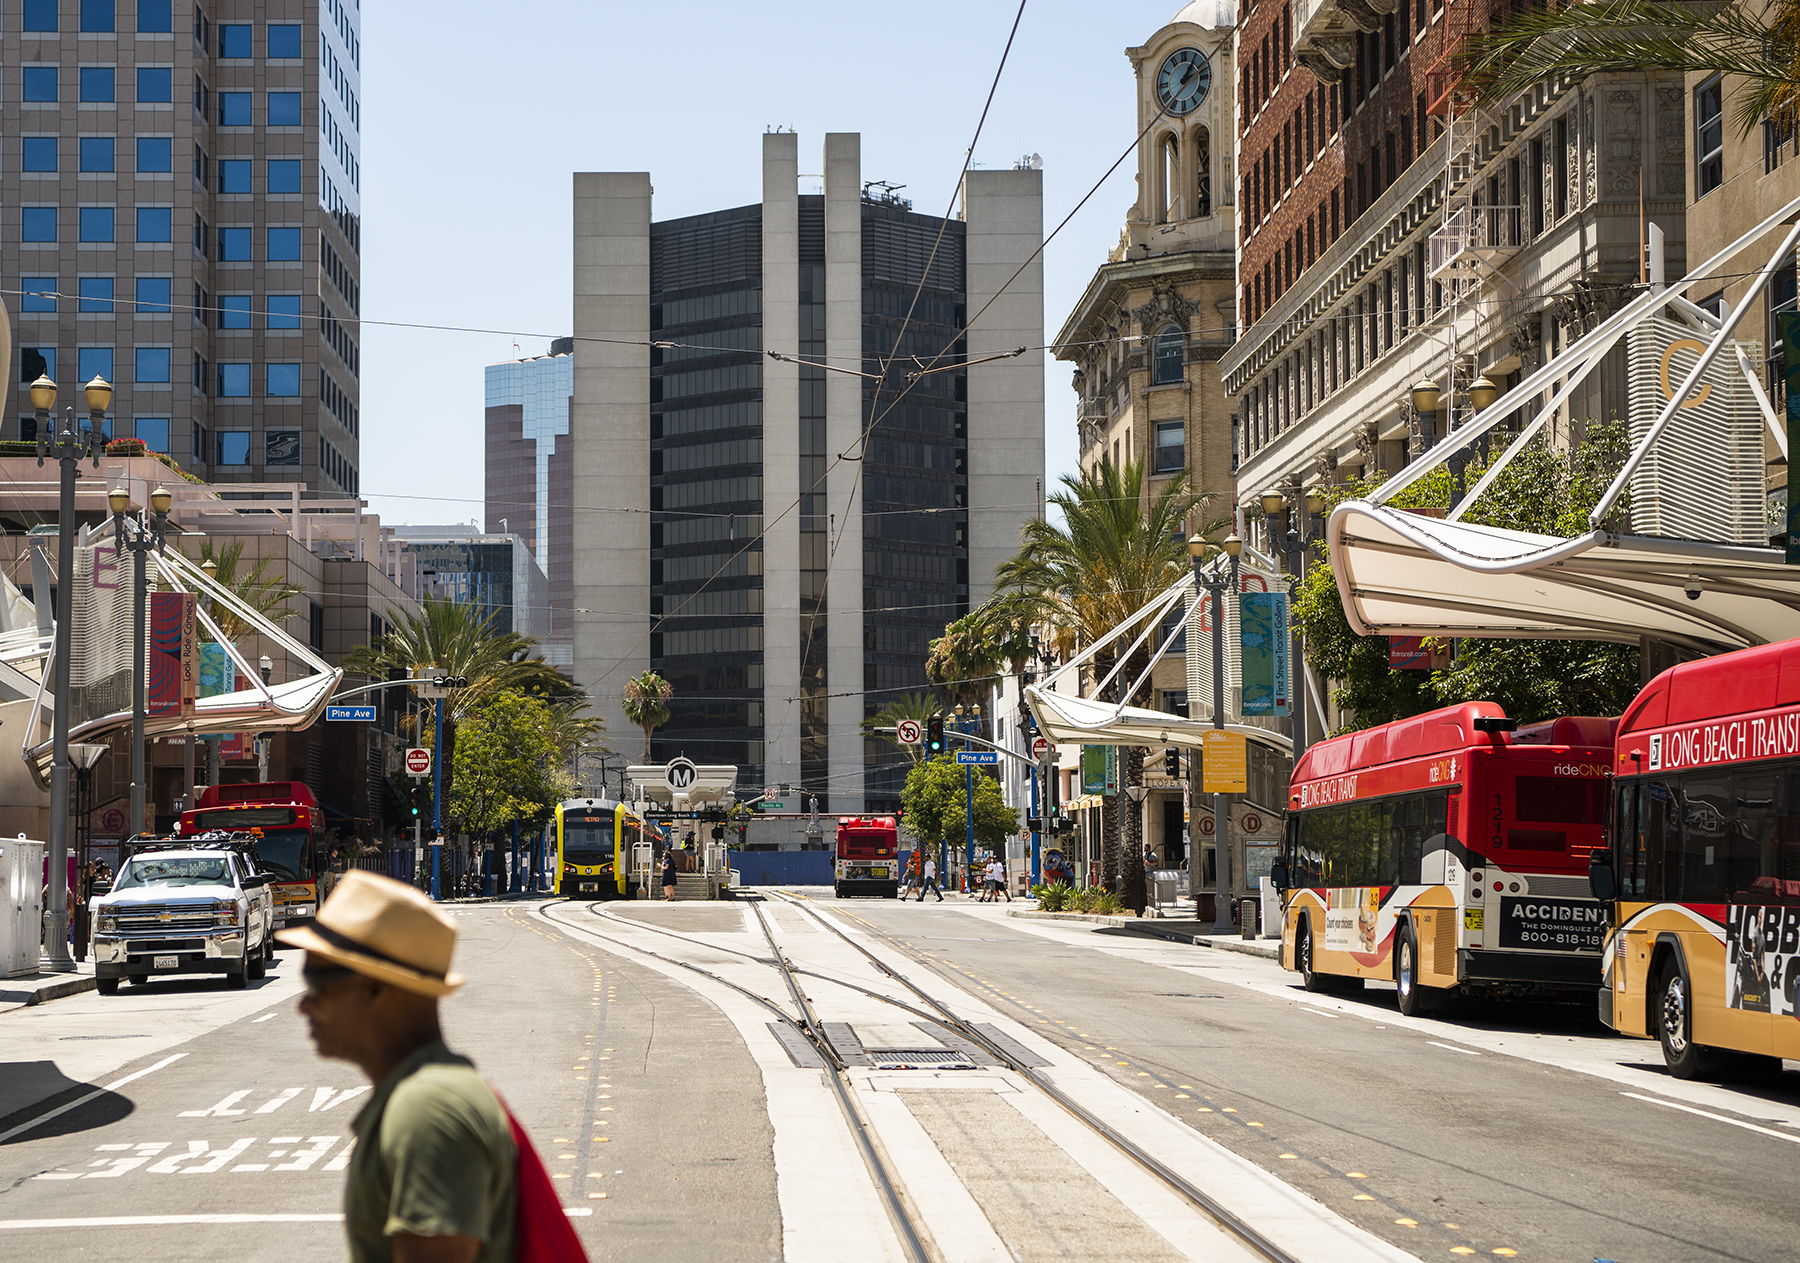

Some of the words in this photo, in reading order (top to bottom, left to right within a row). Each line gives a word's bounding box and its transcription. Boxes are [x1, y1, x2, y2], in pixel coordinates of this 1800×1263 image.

[1659, 339, 1712, 408] C
[93, 547, 119, 590] E
[183, 599, 193, 635] Connect.
[1274, 599, 1284, 629] Gallery
[183, 639, 191, 657] Ride.
[1275, 630, 1284, 655] Transit
[1391, 650, 1428, 658] lbtransit.com
[183, 660, 191, 682] Look.
[1276, 656, 1284, 680] Street
[1276, 681, 1284, 696] First
[331, 709, 351, 718] Pine
[354, 709, 371, 718] Ave
[1665, 728, 1700, 768] LONG
[1704, 721, 1747, 763] BEACH
[1751, 713, 1800, 757] TRANSI
[673, 769, 691, 787] M
[1429, 760, 1450, 783] rideCNG
[1554, 763, 1611, 777] rideCNG
[1306, 782, 1320, 806] LONG
[1320, 779, 1338, 804] BEACH
[1338, 774, 1358, 801] TRANSIT
[1491, 793, 1503, 849] 1219
[871, 867, 888, 876] STUBER
[1520, 931, 1604, 945] 800-818-181
[1521, 921, 1539, 930] THE
[1540, 923, 1592, 932] DOMINGUEZ
[1726, 904, 1800, 964] HOBB
[1771, 954, 1783, 990] &
